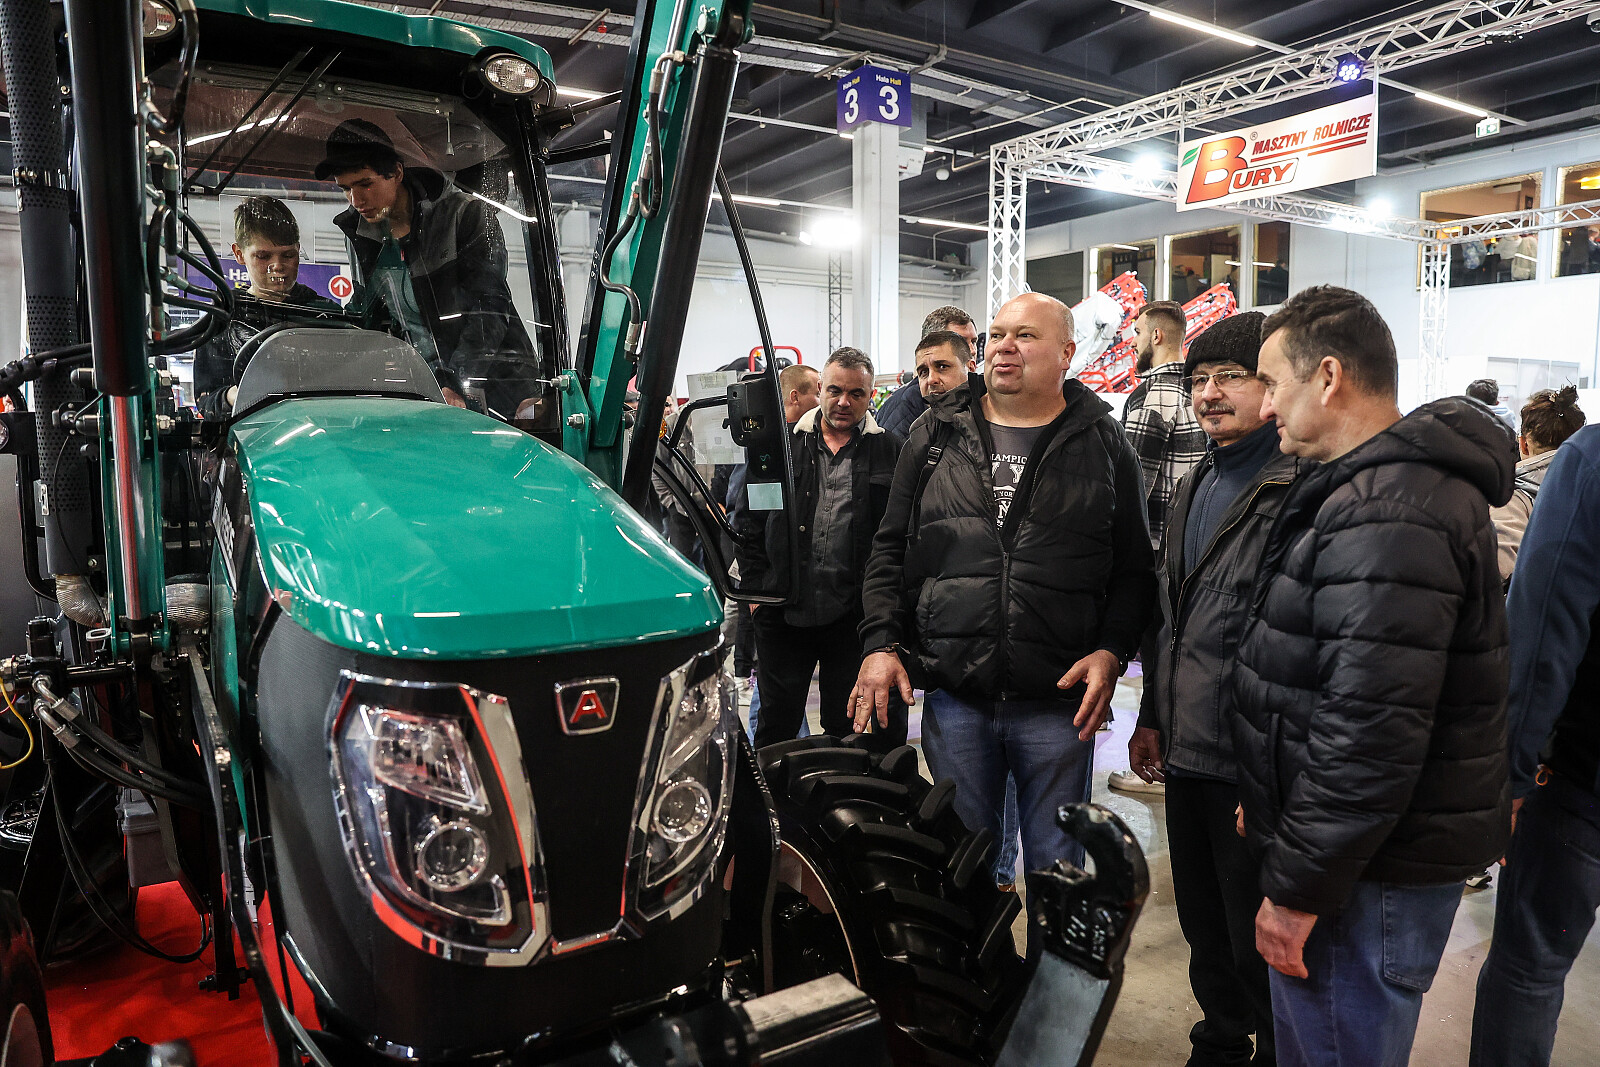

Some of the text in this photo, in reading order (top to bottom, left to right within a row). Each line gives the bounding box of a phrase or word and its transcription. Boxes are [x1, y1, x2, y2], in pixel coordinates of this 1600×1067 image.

[876, 74, 889, 83] Hala
[844, 88, 859, 124] 3
[878, 85, 900, 121] 3
[1252, 113, 1372, 155] MASZYNY ROLNICZE
[569, 689, 608, 723] A
